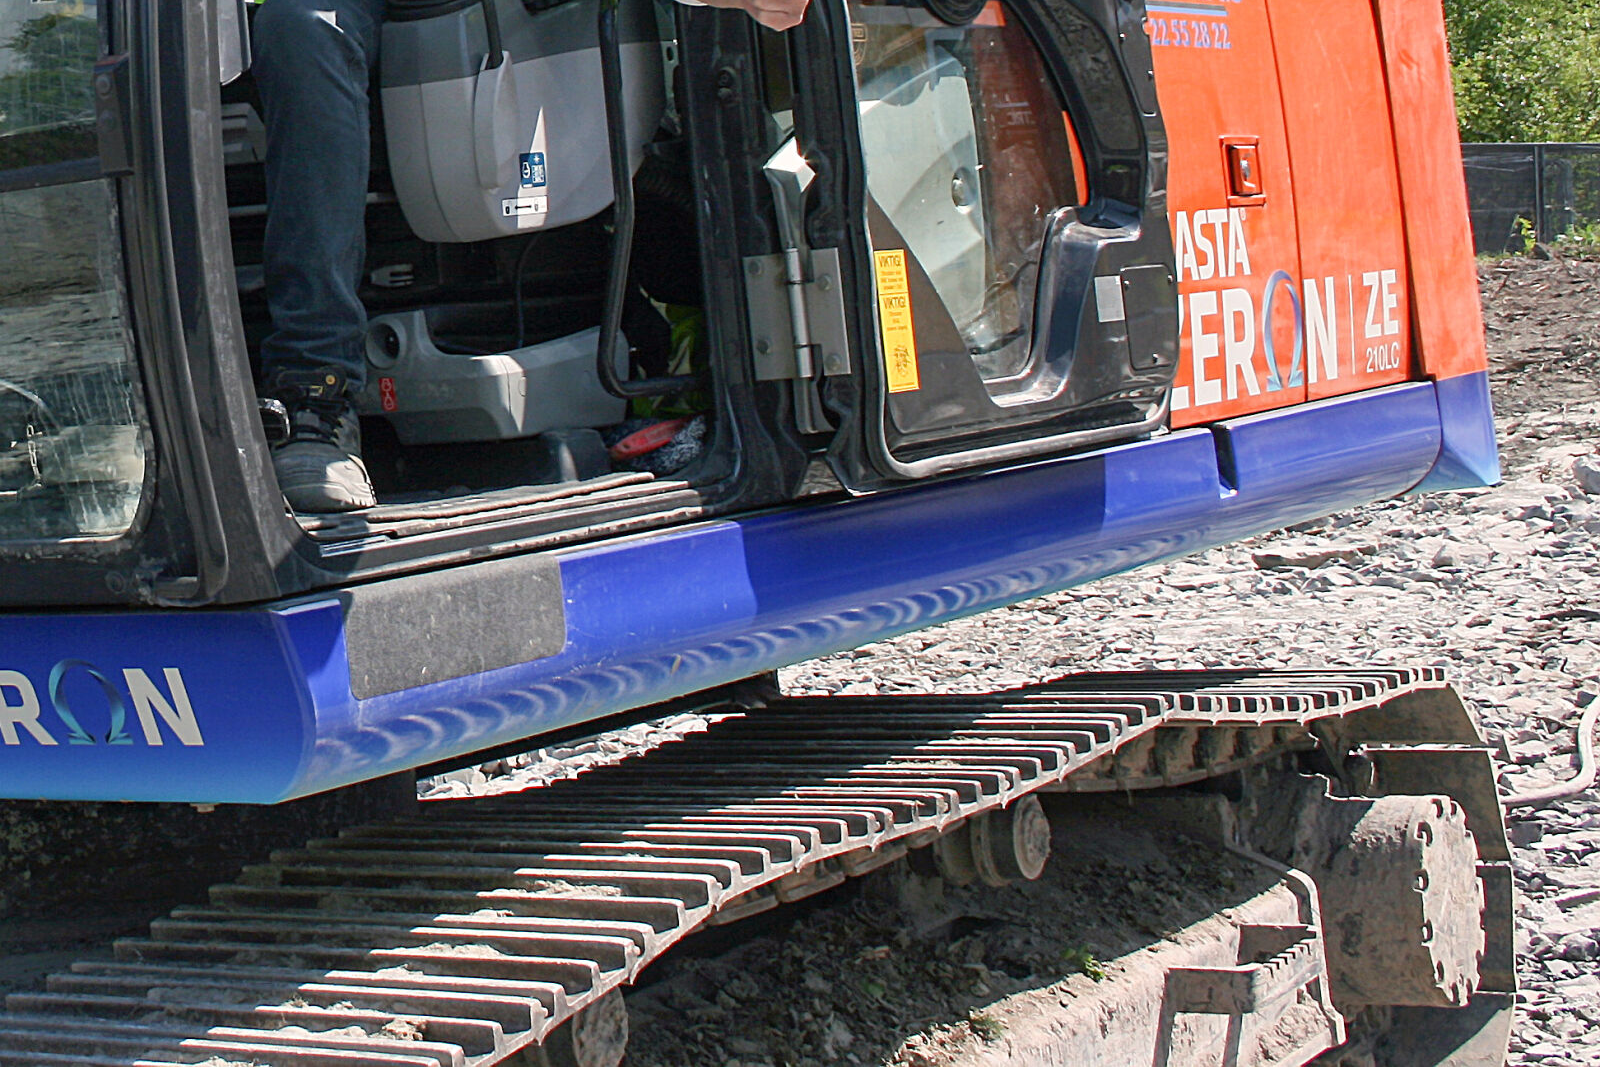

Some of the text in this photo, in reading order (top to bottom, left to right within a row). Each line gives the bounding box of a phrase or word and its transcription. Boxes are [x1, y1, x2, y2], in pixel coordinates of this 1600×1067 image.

[1149, 18, 1232, 49] 22 55 28 22
[1167, 207, 1252, 282] ASTA
[1362, 268, 1400, 339] ZE
[1366, 340, 1400, 373] 210LC
